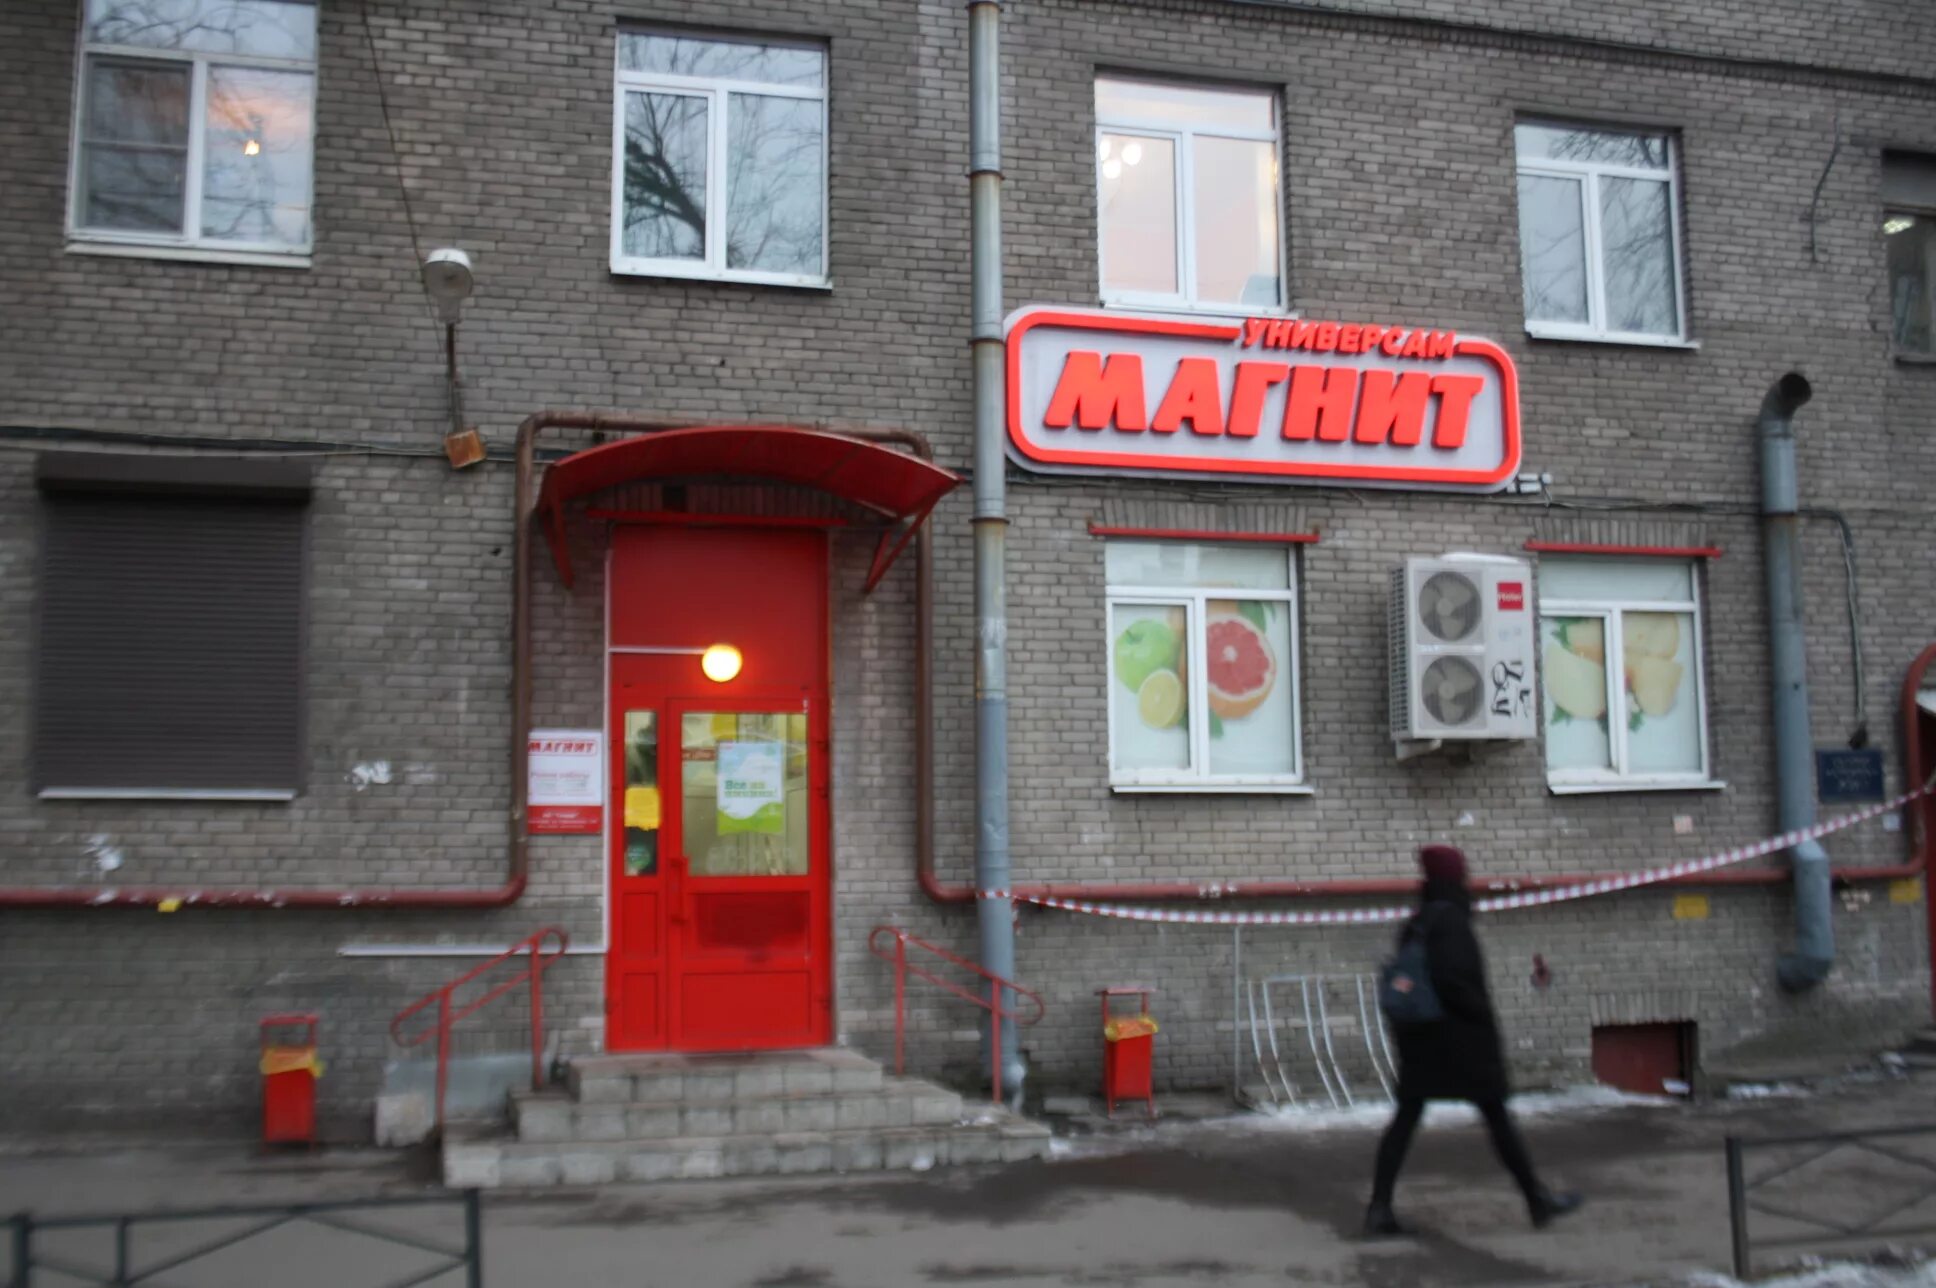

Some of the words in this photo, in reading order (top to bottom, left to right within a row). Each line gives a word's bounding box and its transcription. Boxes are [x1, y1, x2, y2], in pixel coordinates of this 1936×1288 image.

[1244, 319, 1456, 360] УНИВЕРСАМ
[1044, 350, 1485, 449] МАГНИТ
[528, 741, 594, 753] МАГНИТ
